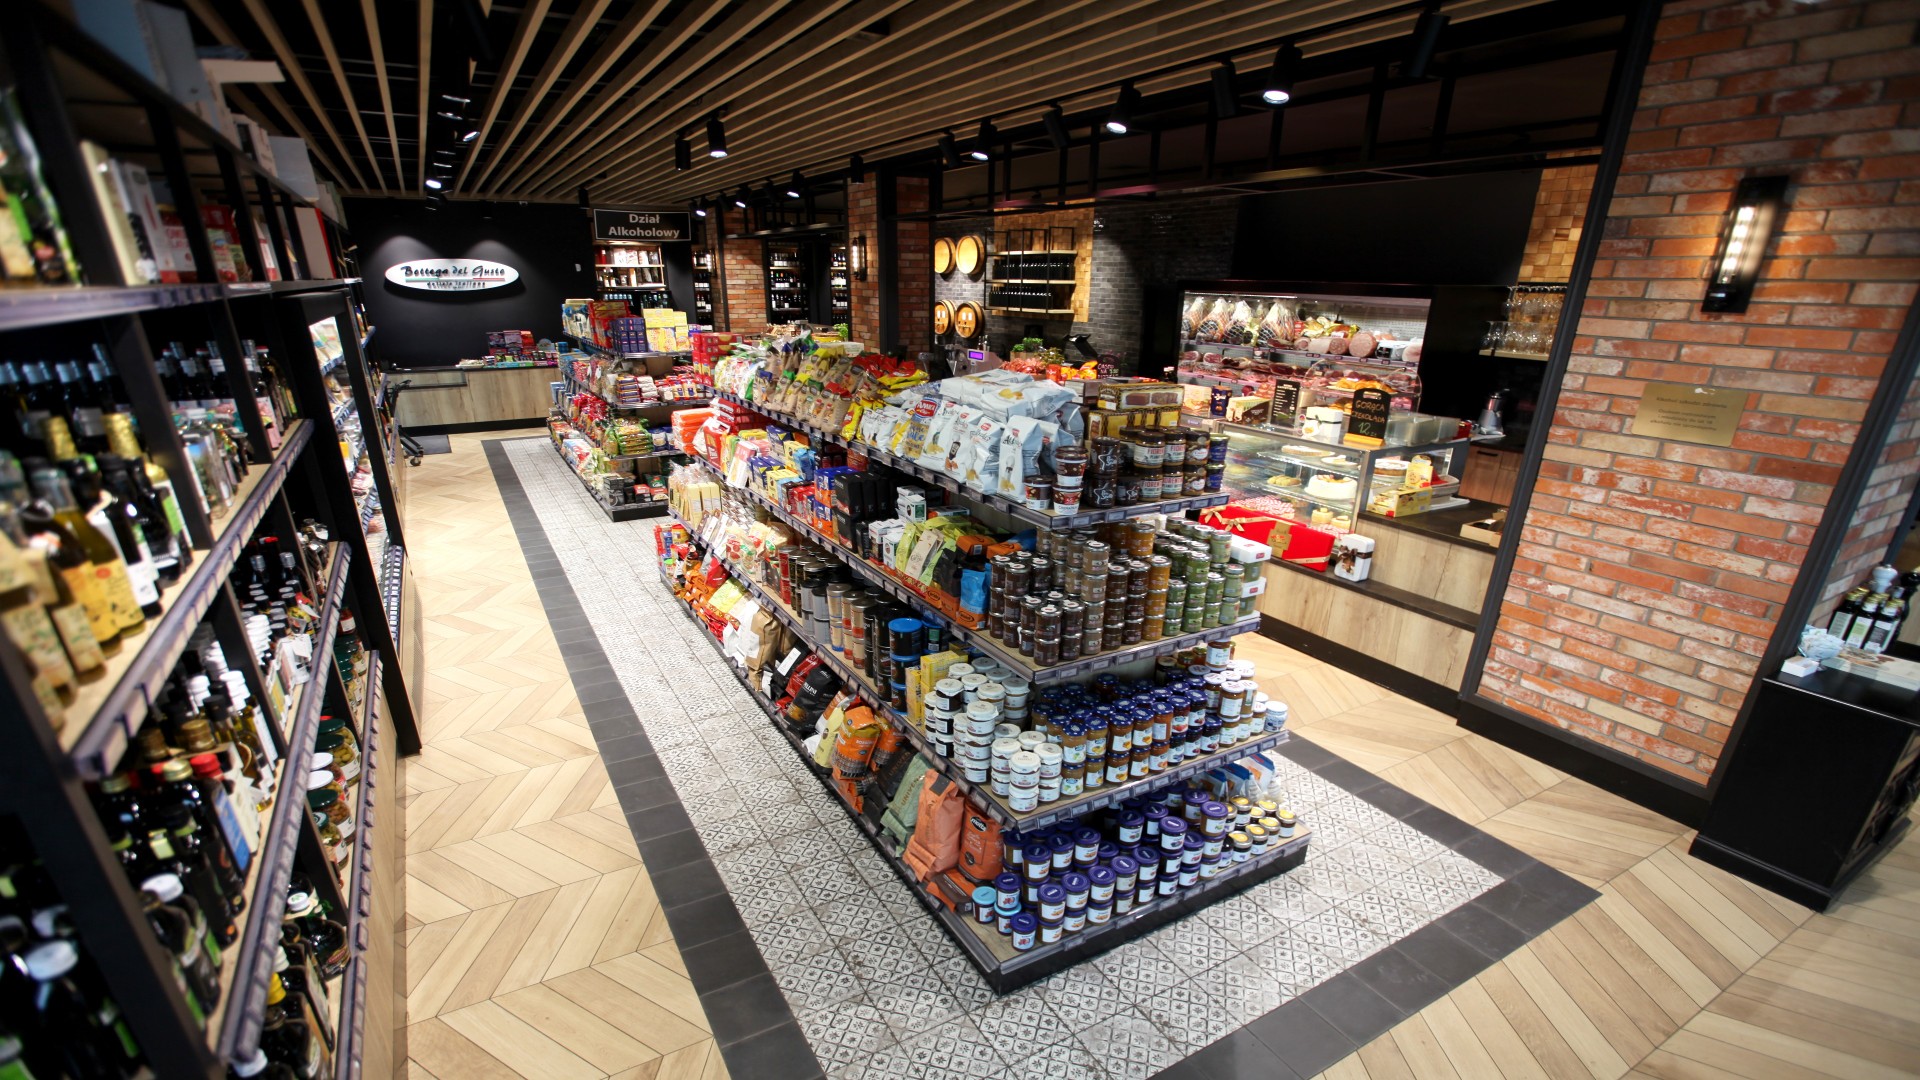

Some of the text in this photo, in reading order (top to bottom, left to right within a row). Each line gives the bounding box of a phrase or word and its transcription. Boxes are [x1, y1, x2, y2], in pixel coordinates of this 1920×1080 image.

[629, 213, 660, 224] Dział
[608, 226, 680, 238] Alkoholowy
[401, 266, 505, 278] Bottega del Gusto
[1356, 400, 1384, 412] GORĄCA
[1358, 422, 1372, 436] 12
